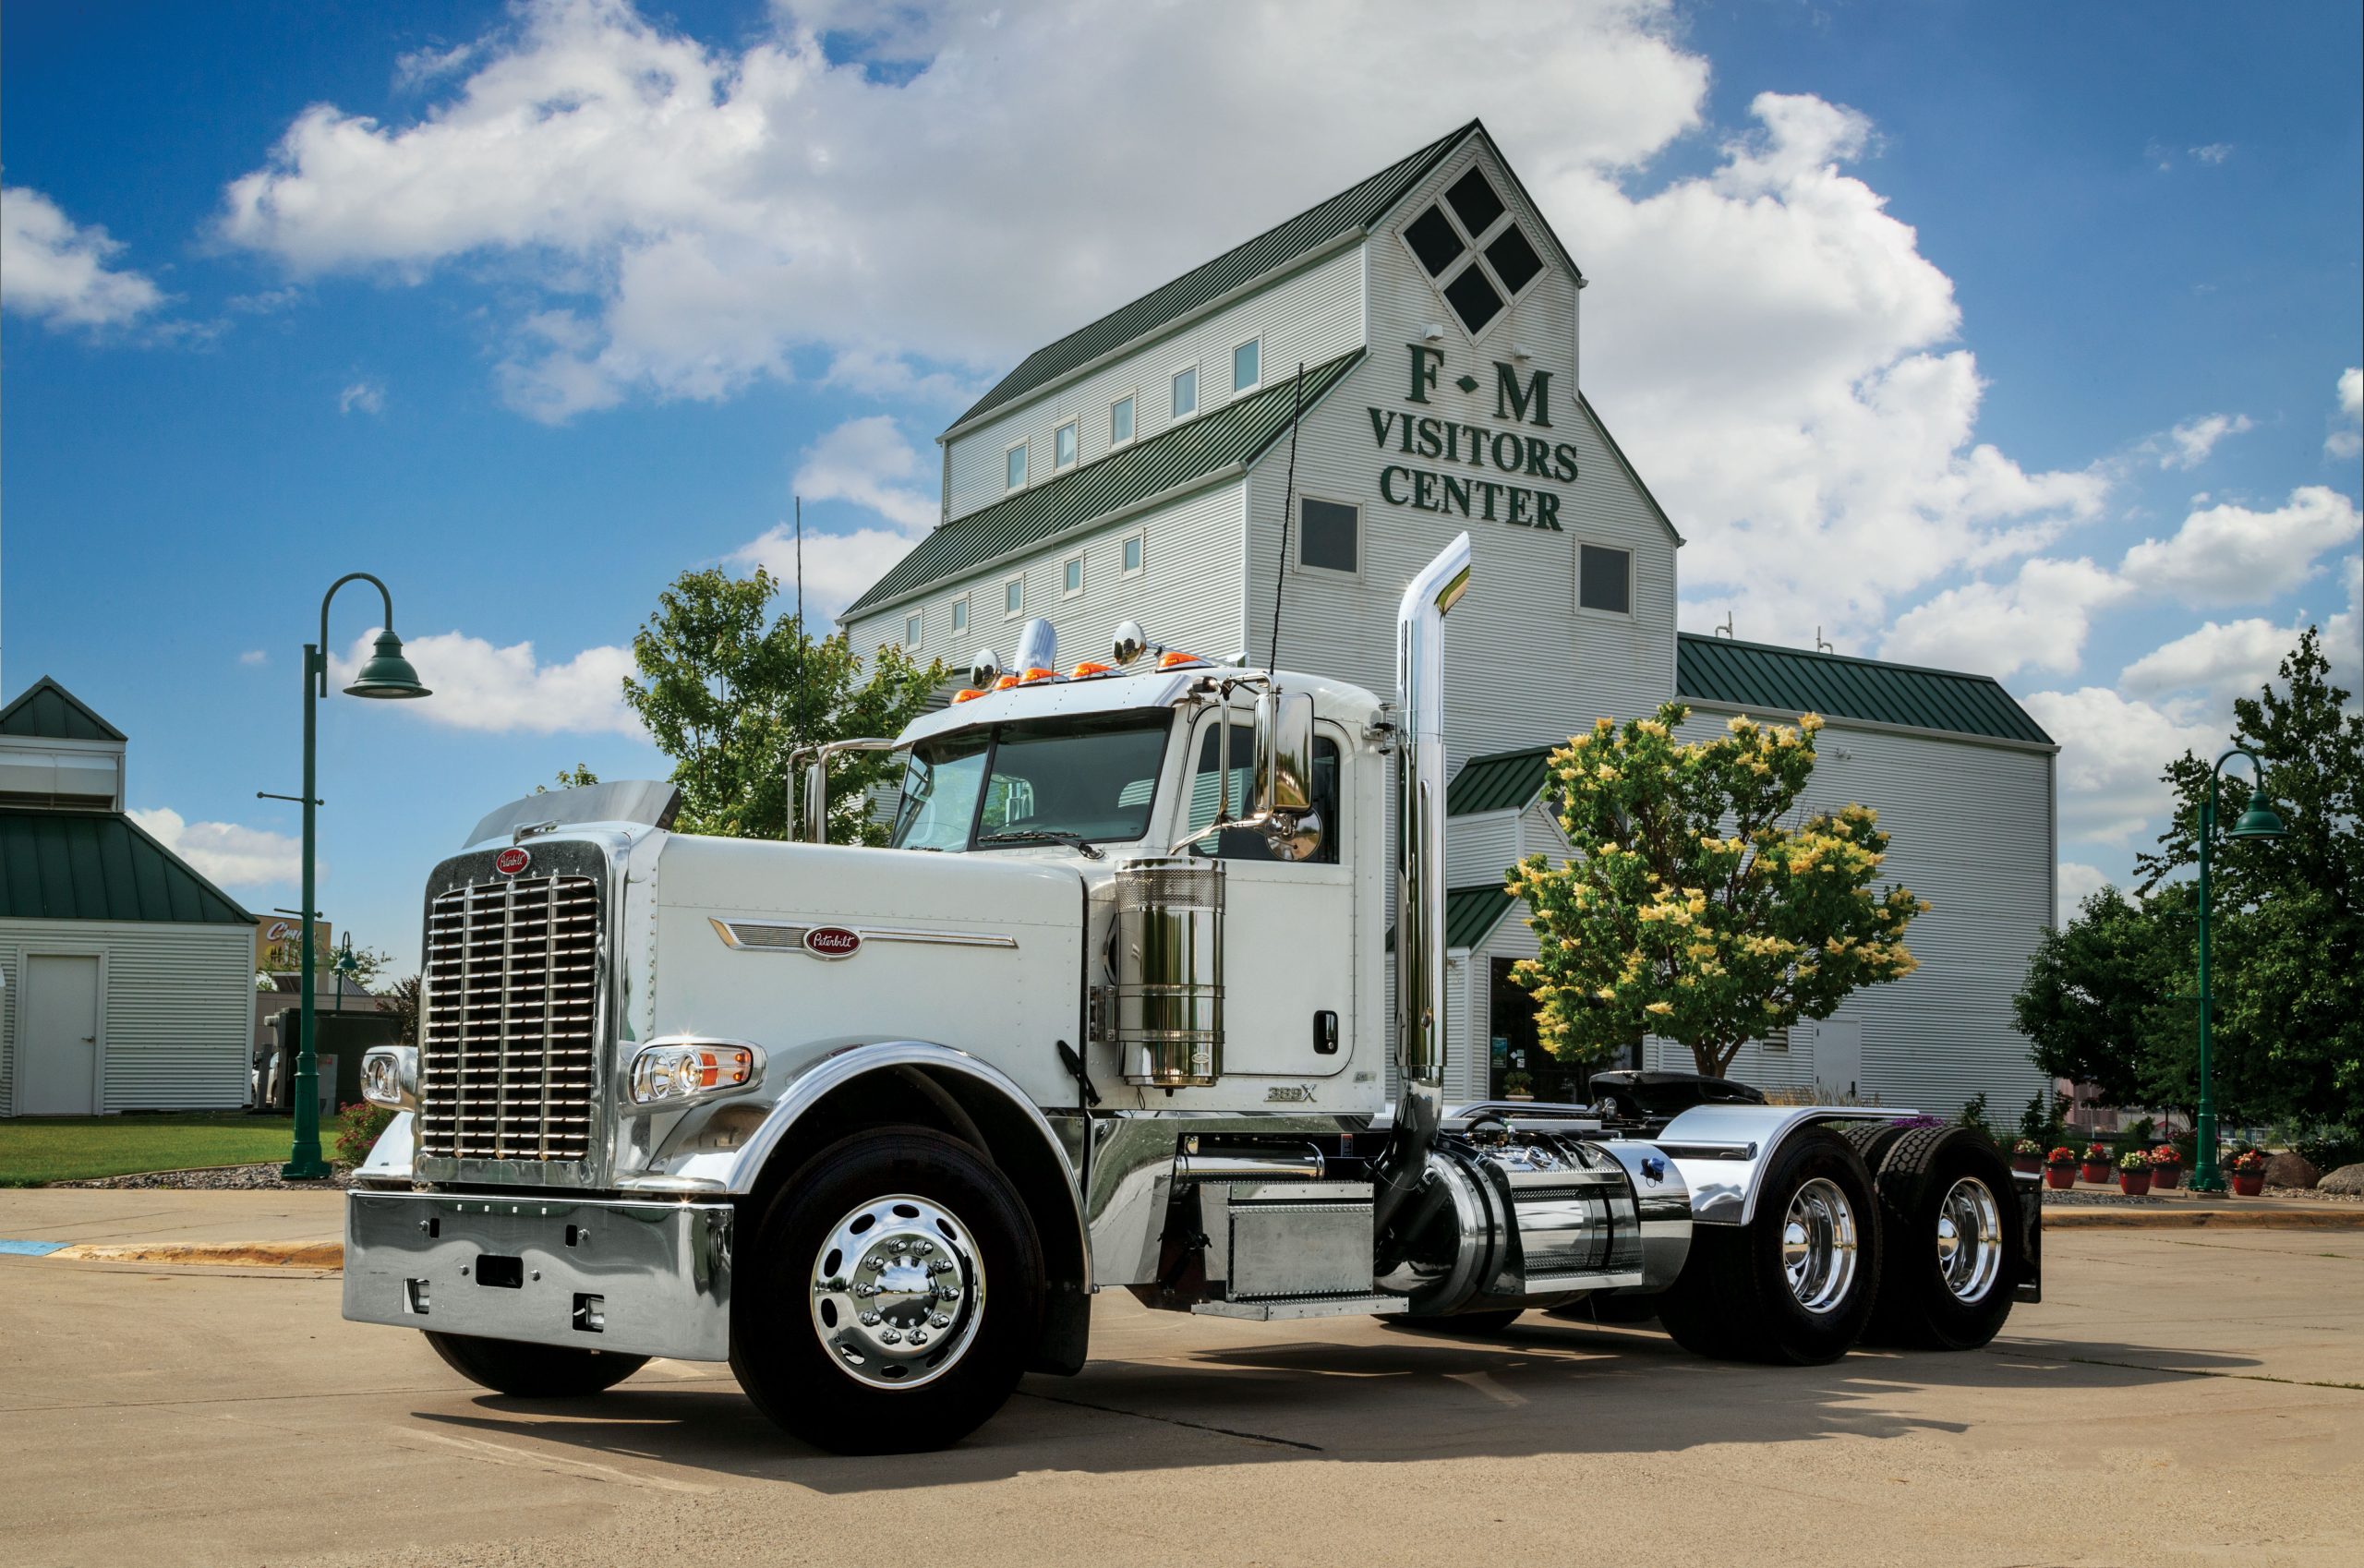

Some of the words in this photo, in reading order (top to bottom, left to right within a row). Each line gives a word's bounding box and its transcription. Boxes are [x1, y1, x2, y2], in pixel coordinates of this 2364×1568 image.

[1405, 343, 1444, 404] F
[1492, 360, 1554, 428] M
[1367, 406, 1579, 483] VISITORS
[1380, 464, 1563, 532] CENTER
[500, 853, 525, 869] Peterbilt
[813, 932, 855, 947] Peterbilt
